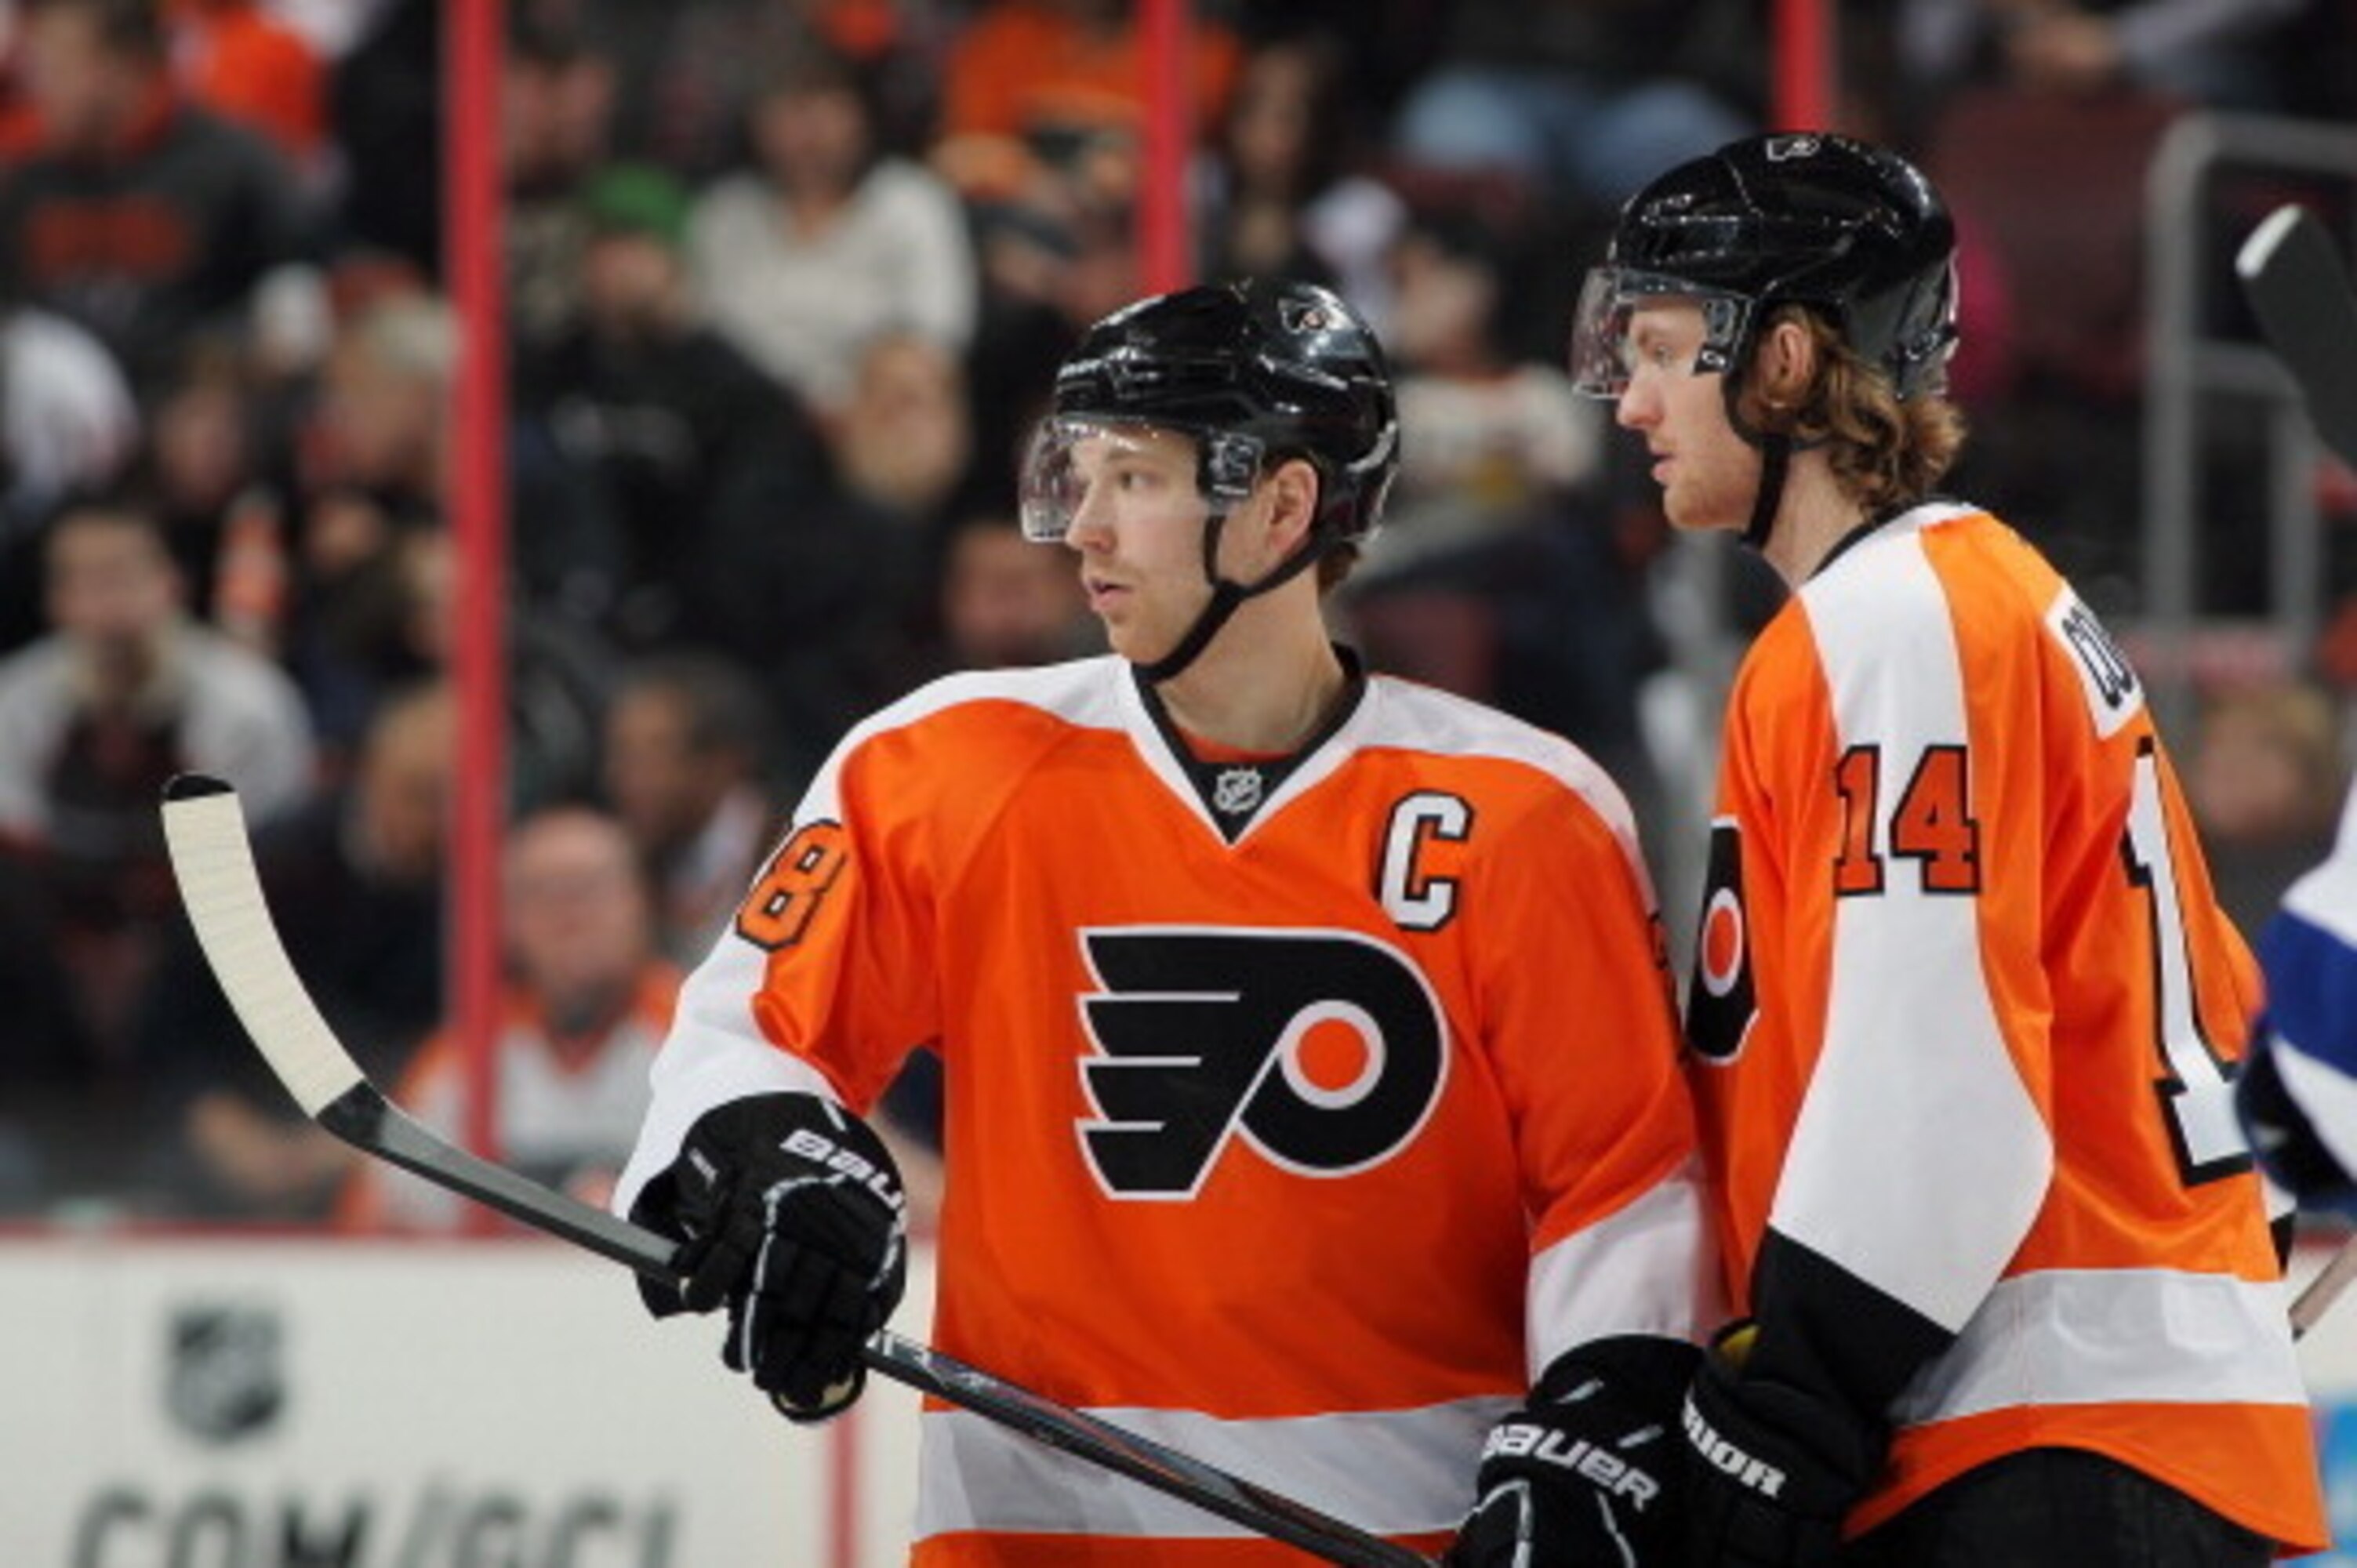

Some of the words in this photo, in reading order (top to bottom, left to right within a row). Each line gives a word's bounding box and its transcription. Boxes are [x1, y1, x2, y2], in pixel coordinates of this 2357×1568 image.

[735, 818, 846, 953] 8
[1374, 789, 1475, 934] C
[1833, 742, 1981, 896] 14
[2119, 735, 2253, 1188] 1
